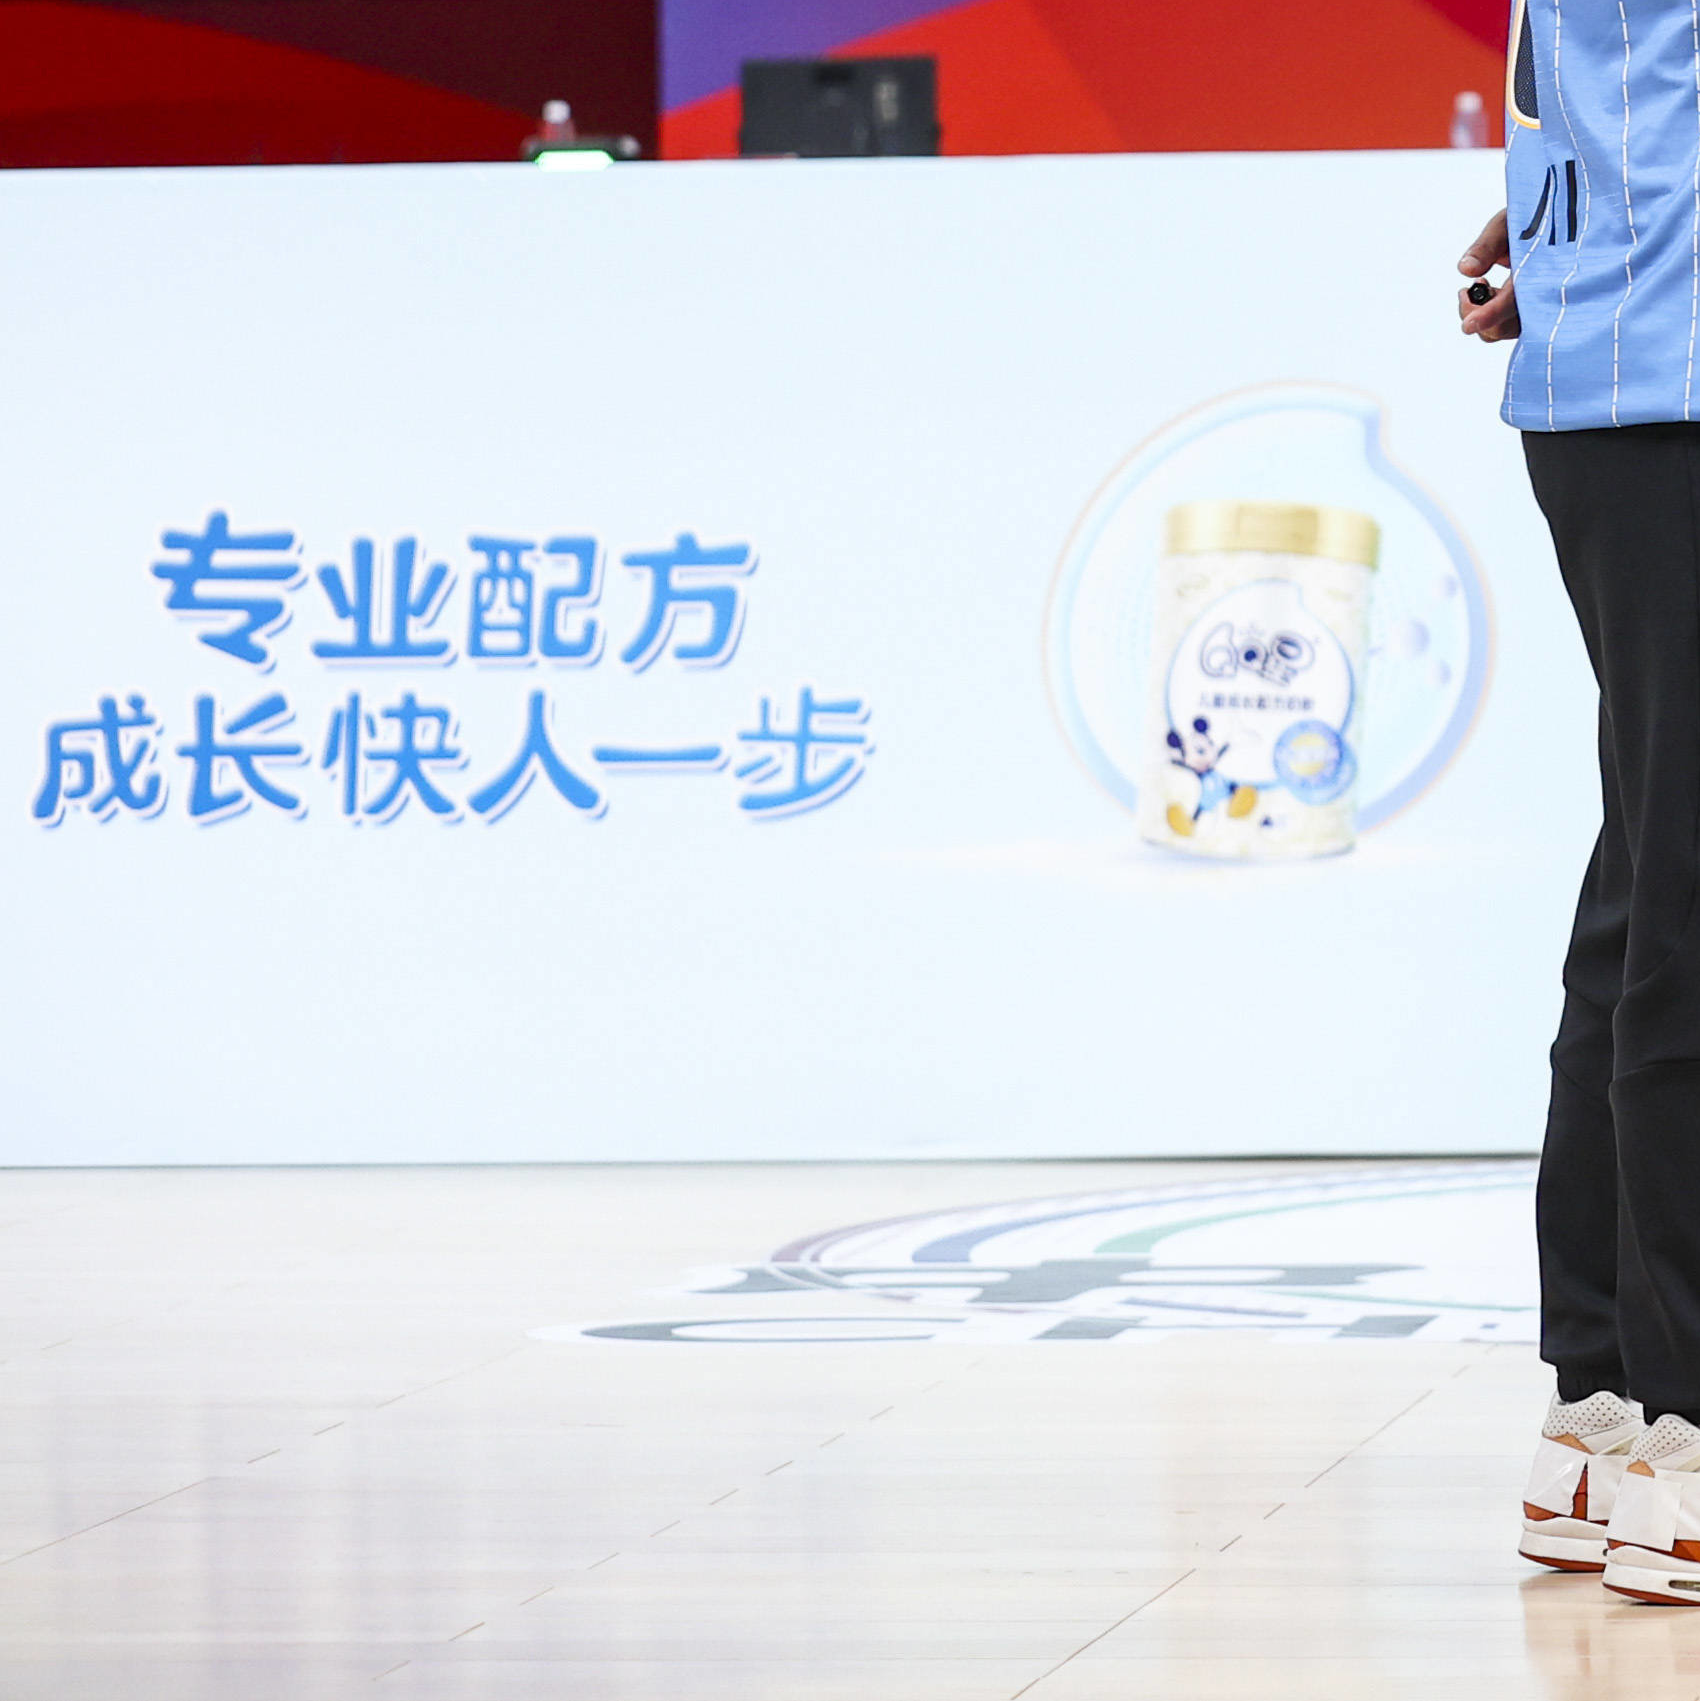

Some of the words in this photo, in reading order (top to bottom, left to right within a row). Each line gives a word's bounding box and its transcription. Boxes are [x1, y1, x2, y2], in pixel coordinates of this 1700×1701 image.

[148, 508, 762, 672] 专业配方
[31, 686, 882, 829] 成长快人一步
